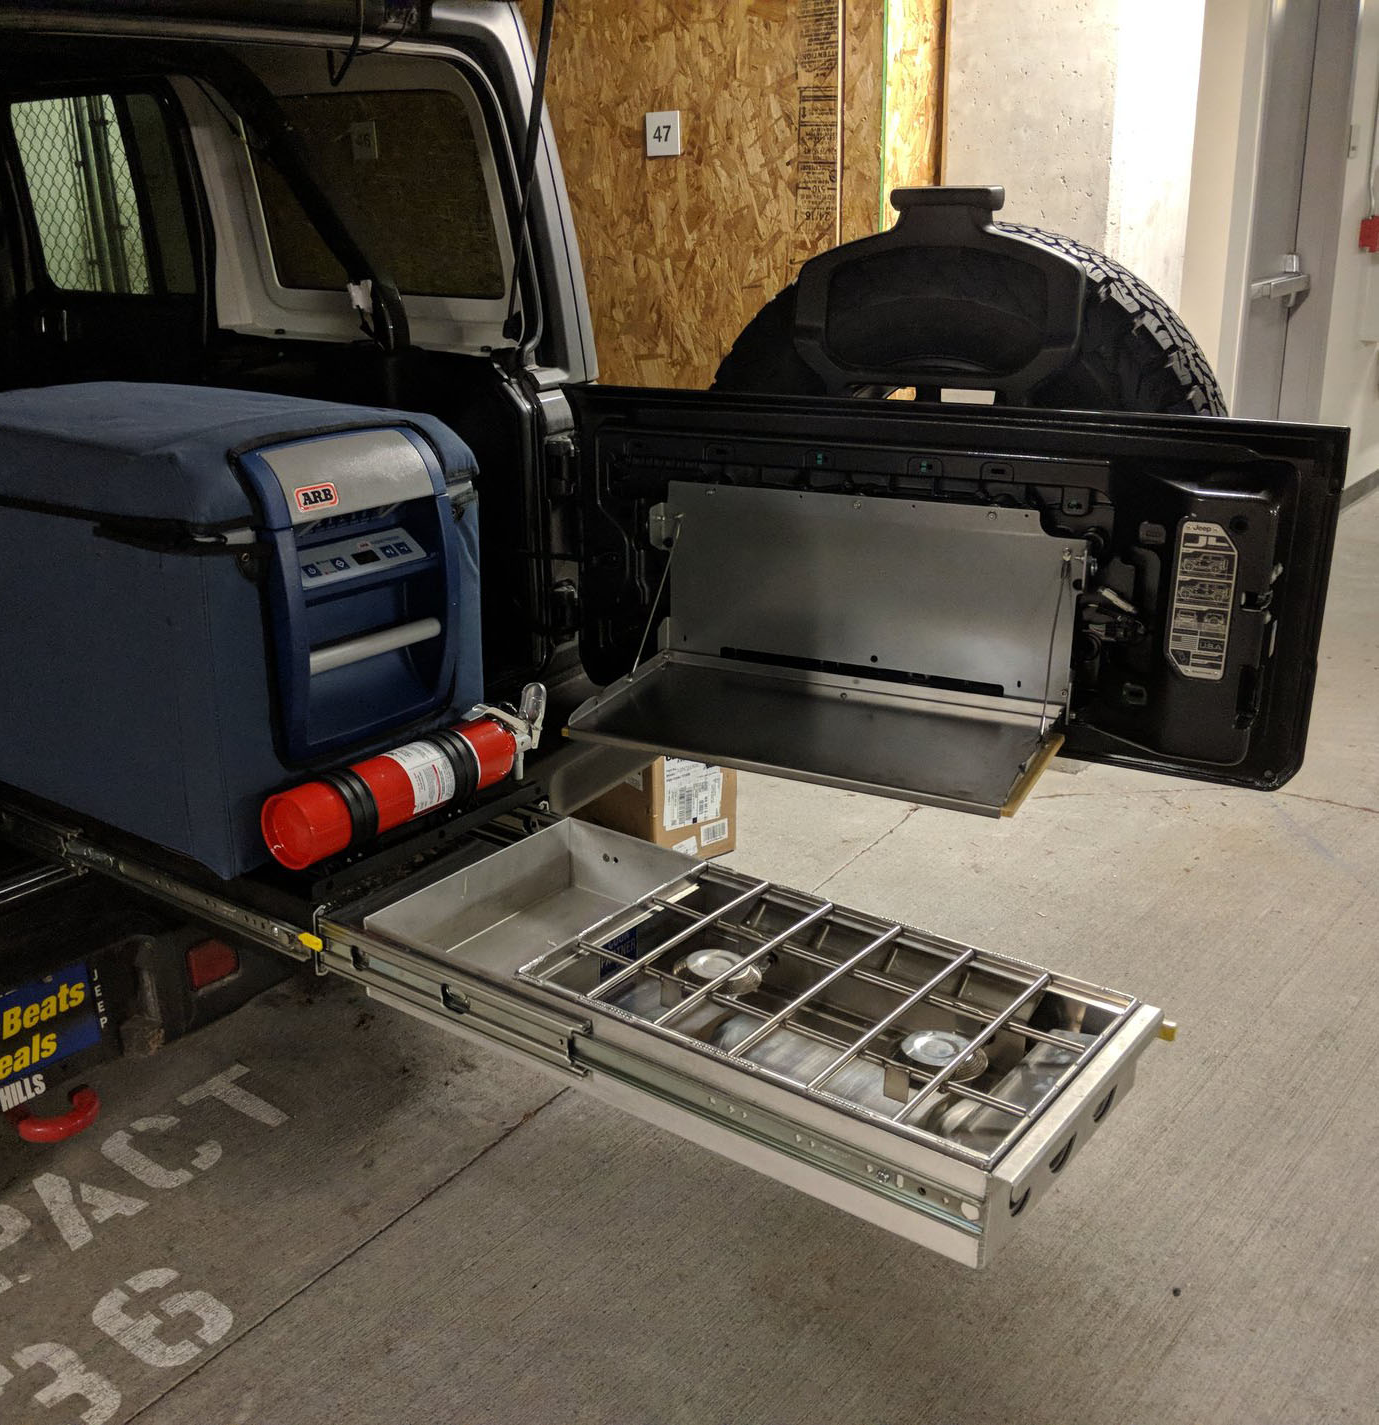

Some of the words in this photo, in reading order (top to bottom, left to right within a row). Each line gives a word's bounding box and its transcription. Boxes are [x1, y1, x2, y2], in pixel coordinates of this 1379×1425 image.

[652, 125, 672, 142] 47
[302, 488, 334, 506] ARB
[1193, 525, 1212, 533] Jeep
[1184, 535, 1230, 548] JL
[92, 968, 109, 1030] JEEP
[2, 981, 86, 1040] Beats
